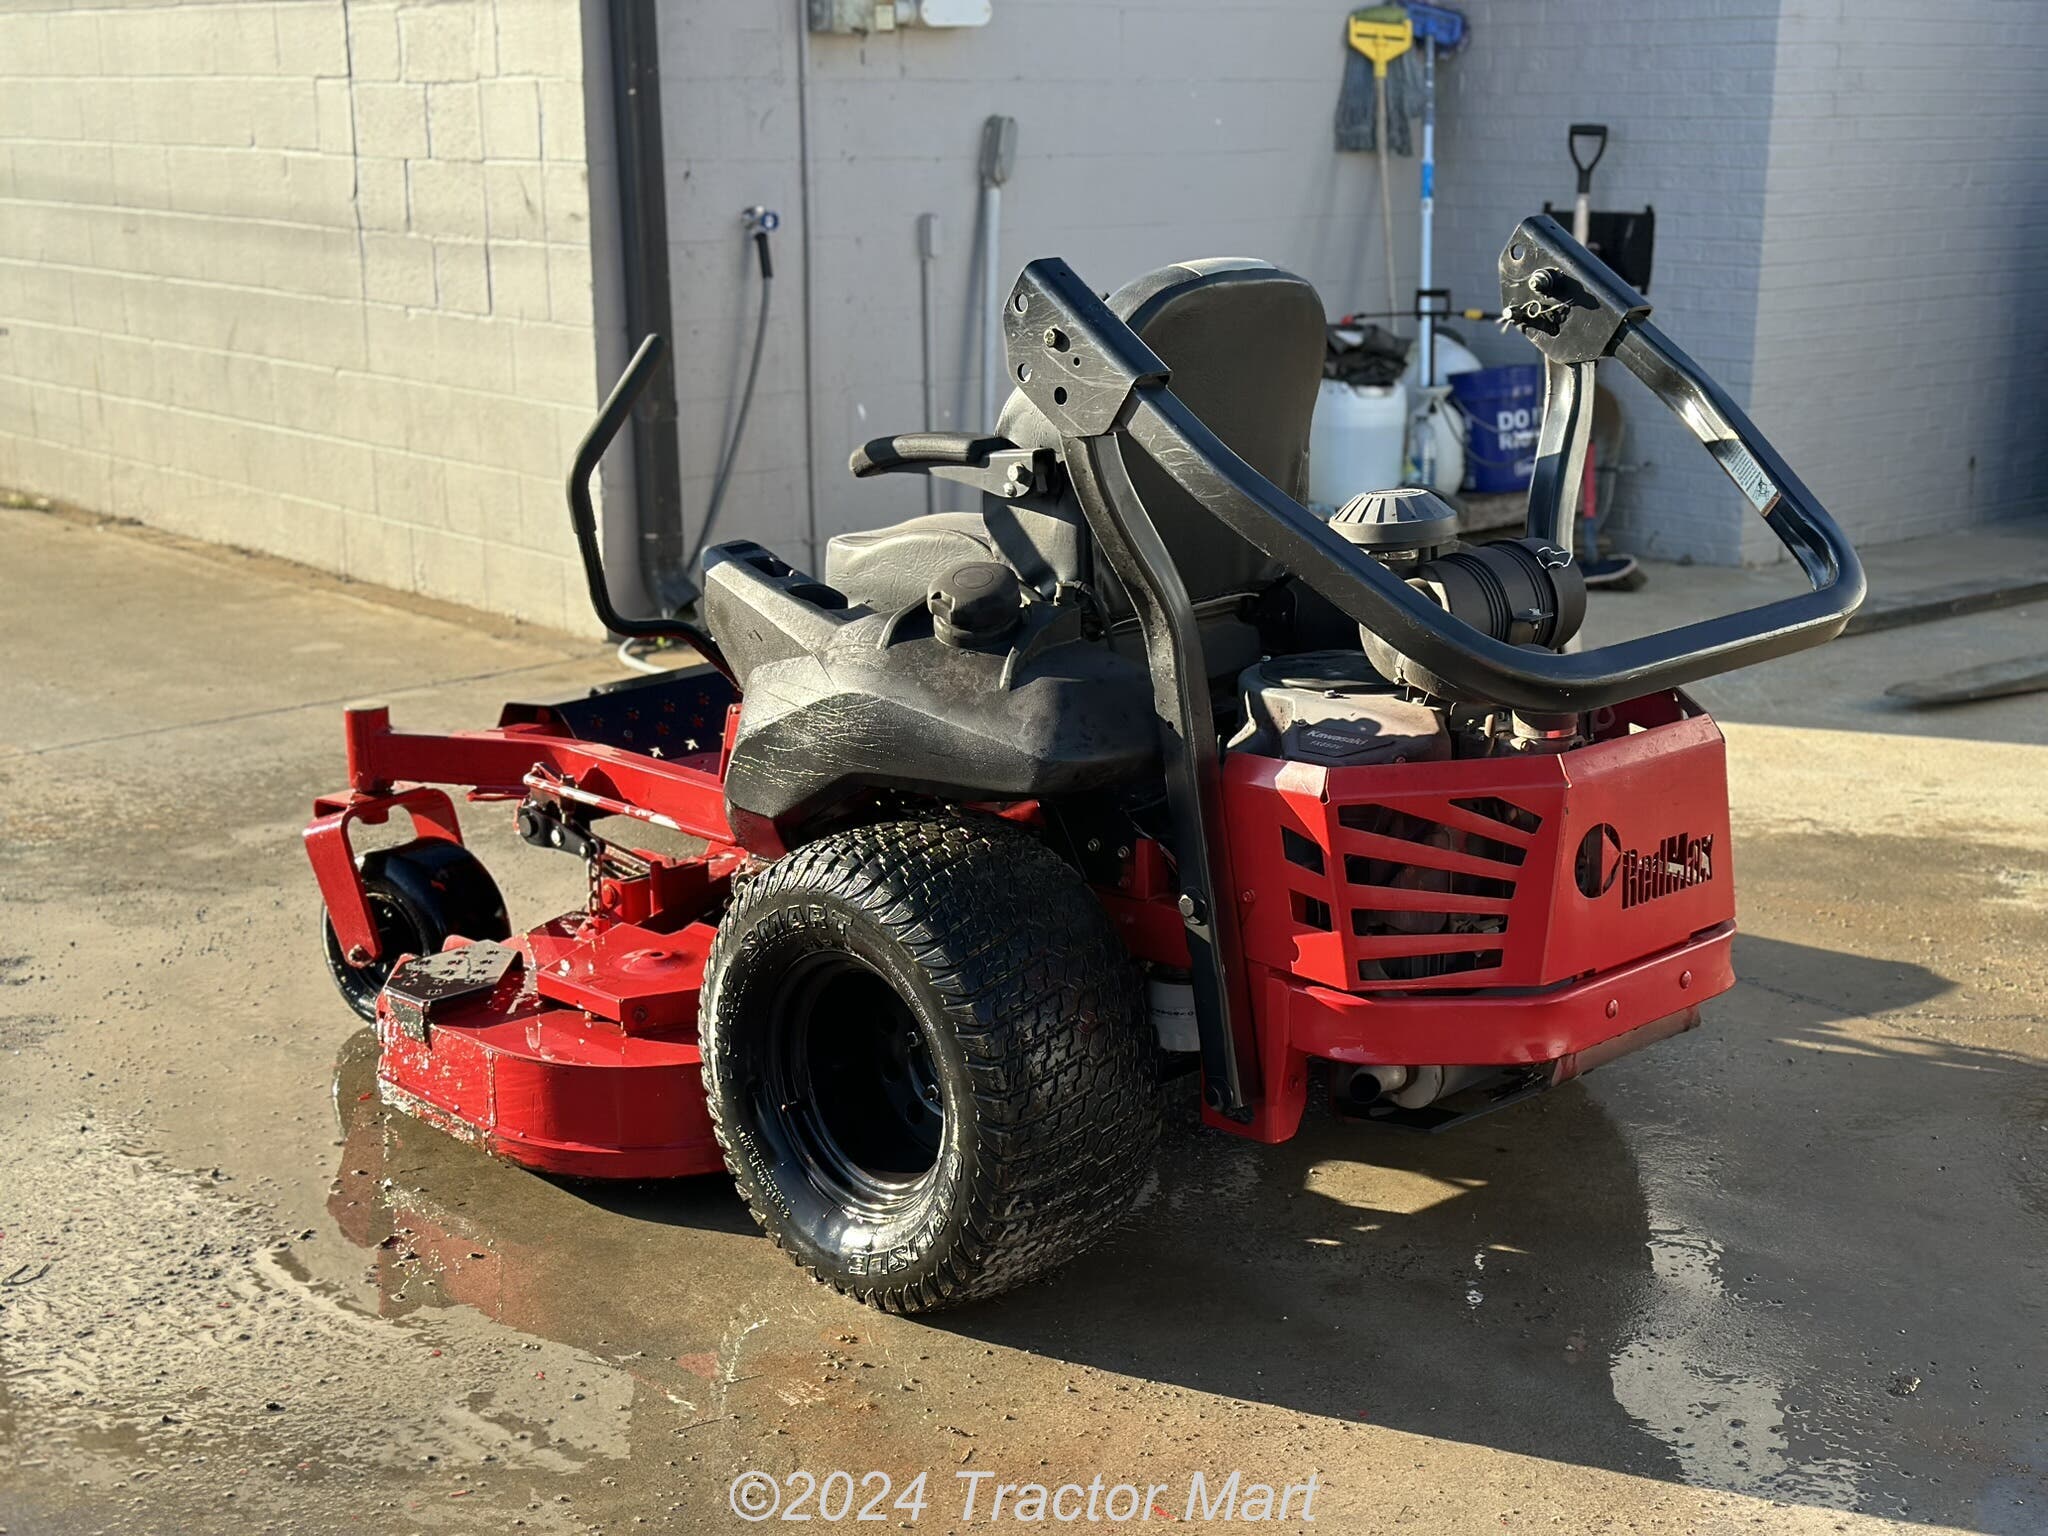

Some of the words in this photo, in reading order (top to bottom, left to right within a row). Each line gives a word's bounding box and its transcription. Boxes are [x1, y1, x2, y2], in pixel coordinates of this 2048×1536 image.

[1497, 408, 1530, 432] DO
[1306, 729, 1369, 746] Kawasaki
[1622, 831, 1714, 910] RedMax
[740, 903, 854, 962] SMART
